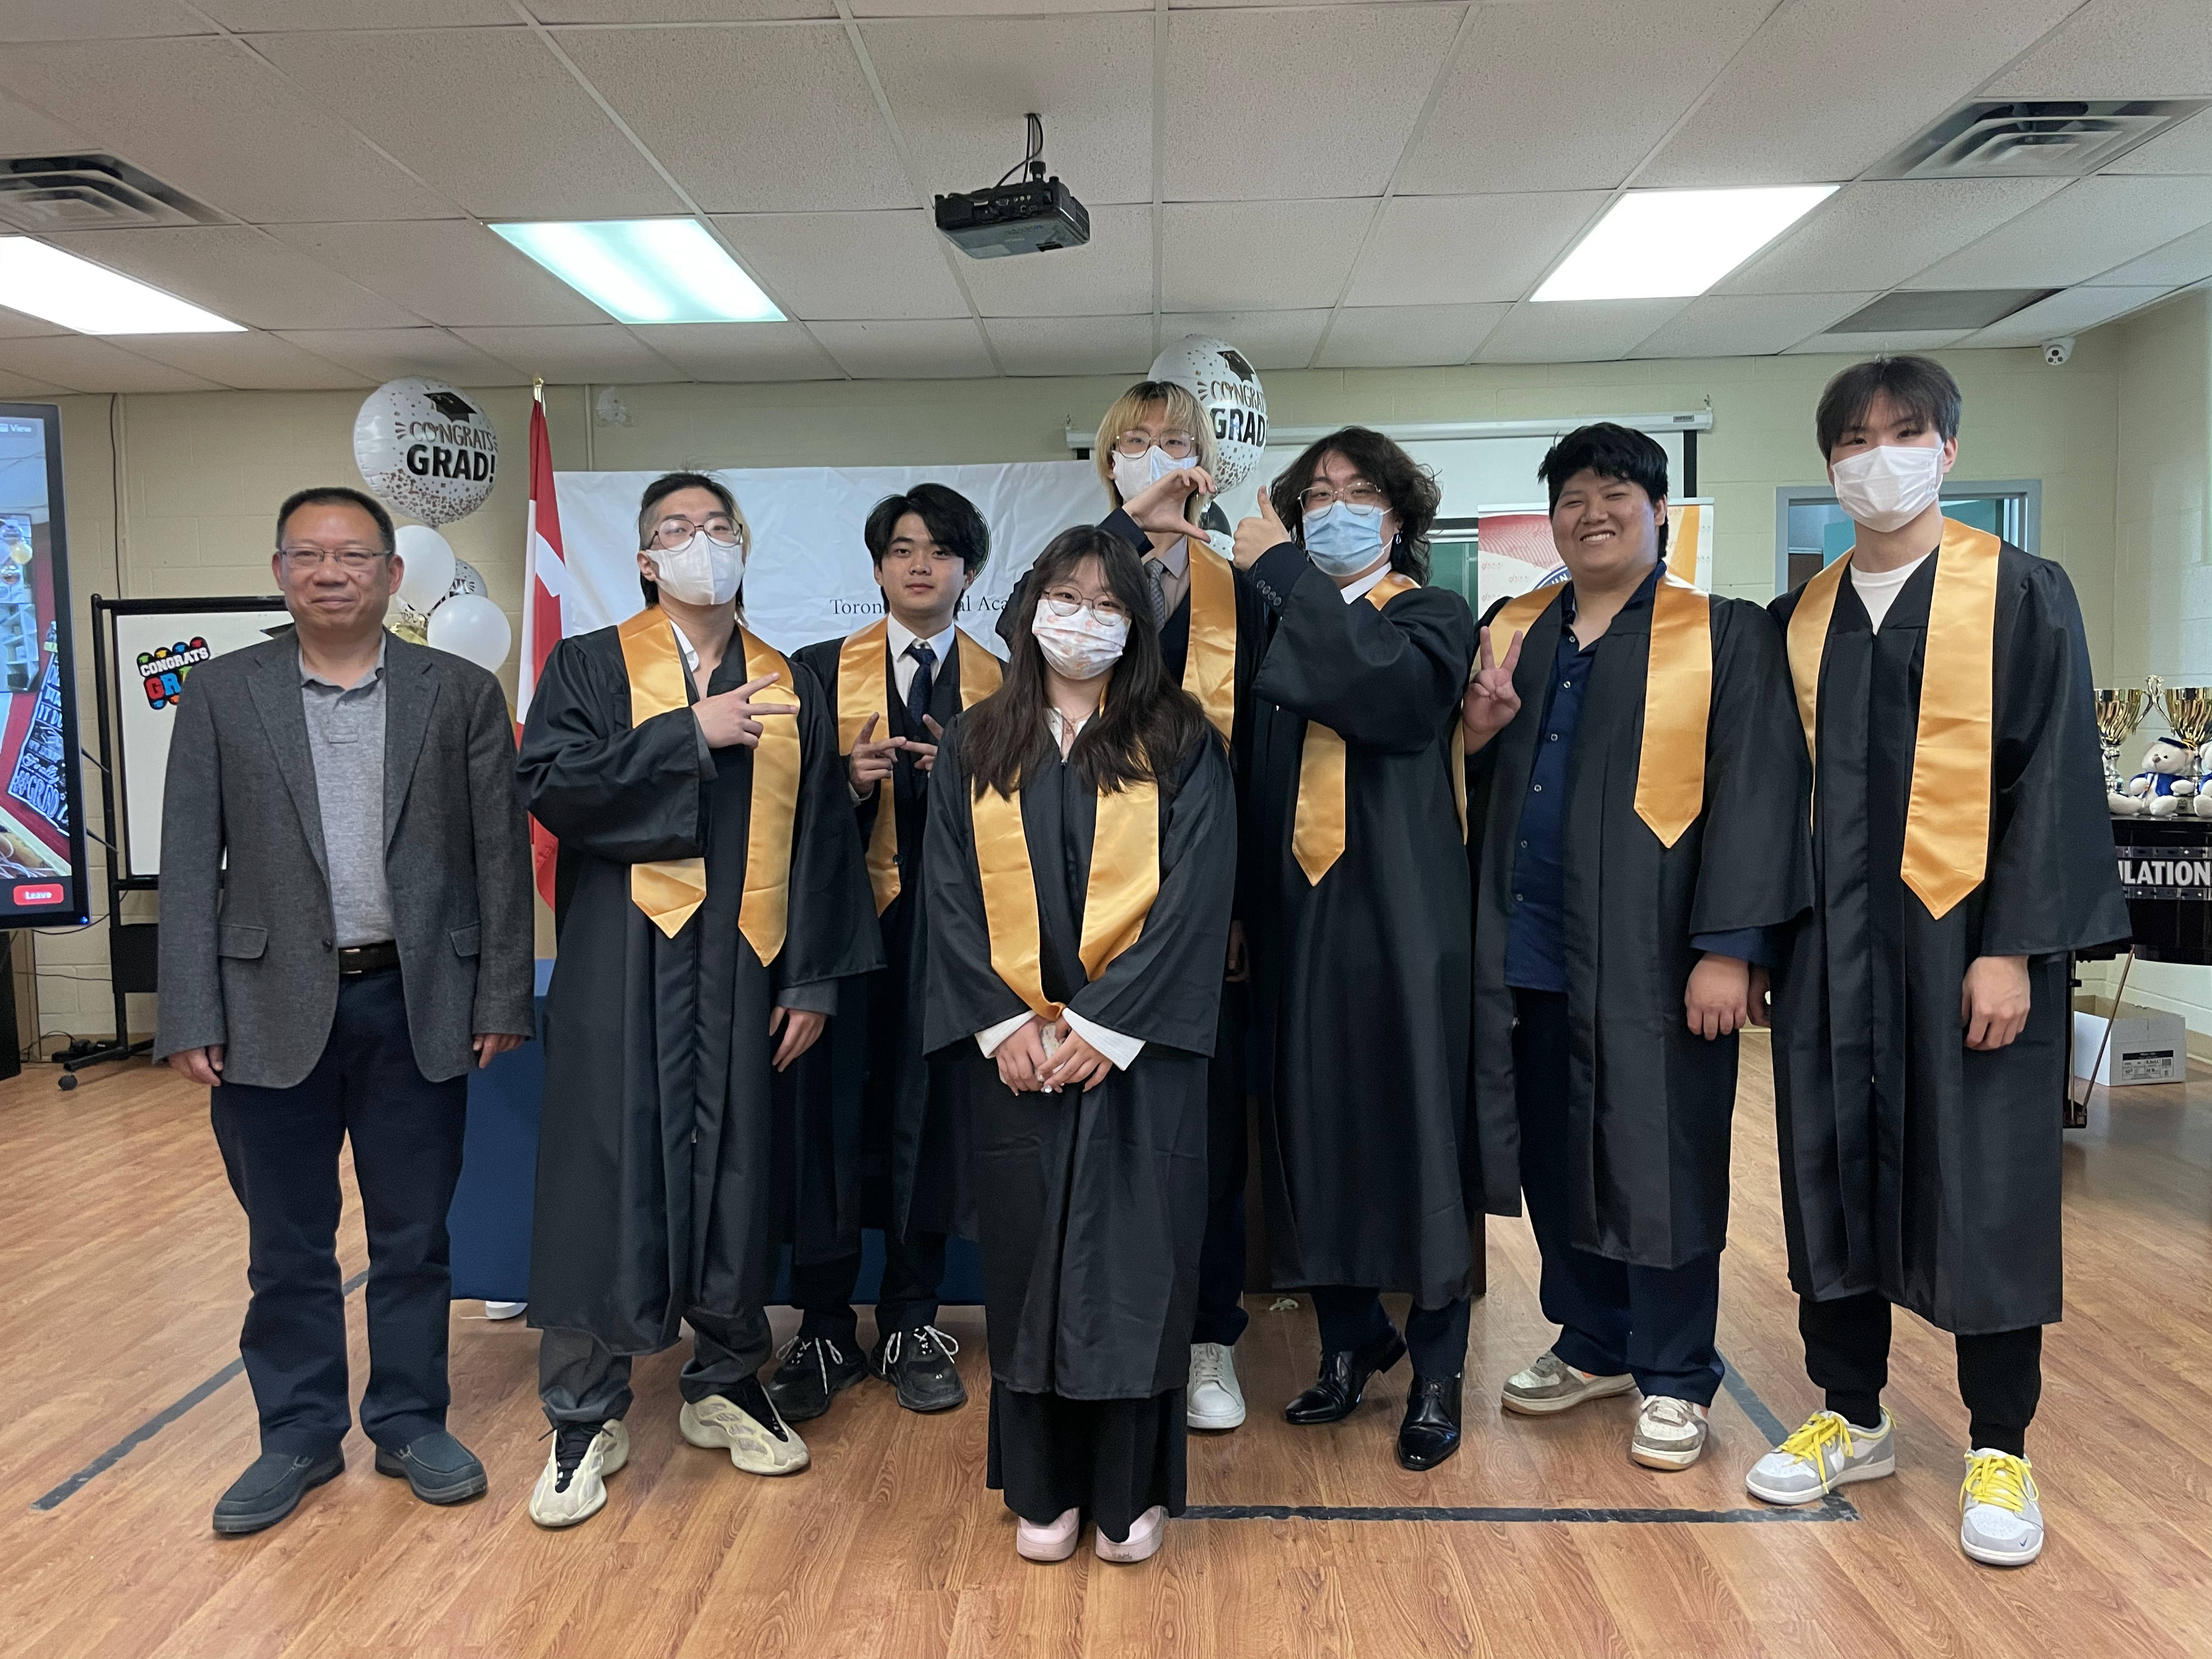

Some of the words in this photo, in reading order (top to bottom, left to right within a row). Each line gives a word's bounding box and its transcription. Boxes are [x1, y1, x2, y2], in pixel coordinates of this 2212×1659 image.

[1210, 380, 1266, 414] CONGRAT
[409, 421, 494, 452] CONGRATS
[407, 444, 495, 483] GRAD!
[830, 599, 882, 614] Toron
[959, 595, 972, 612] al
[140, 647, 209, 677] CONGRATS
[145, 673, 184, 700] GR
[2118, 860, 2211, 886] LATION
[25, 891, 52, 900] Leave
